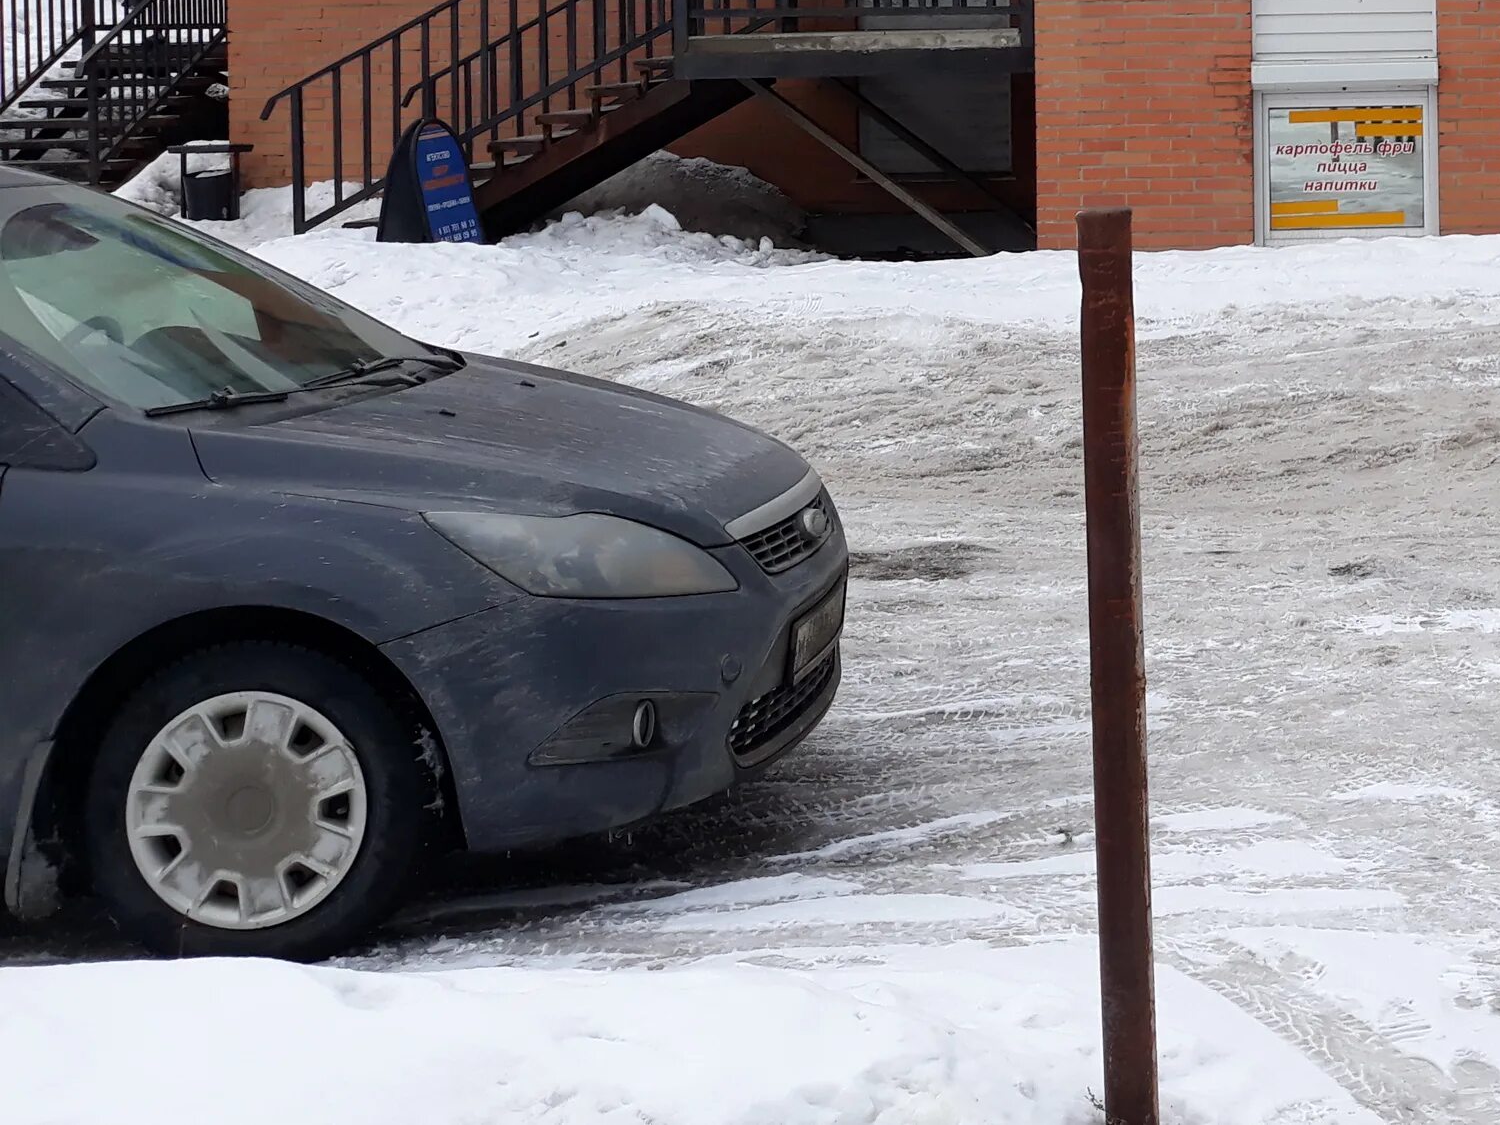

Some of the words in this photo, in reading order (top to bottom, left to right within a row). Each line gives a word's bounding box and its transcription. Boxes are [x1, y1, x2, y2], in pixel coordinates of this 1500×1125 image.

[1276, 140, 1373, 157] картофель
[1377, 140, 1413, 157] фри
[1317, 161, 1368, 174] пицца
[1303, 180, 1378, 192] напитки
